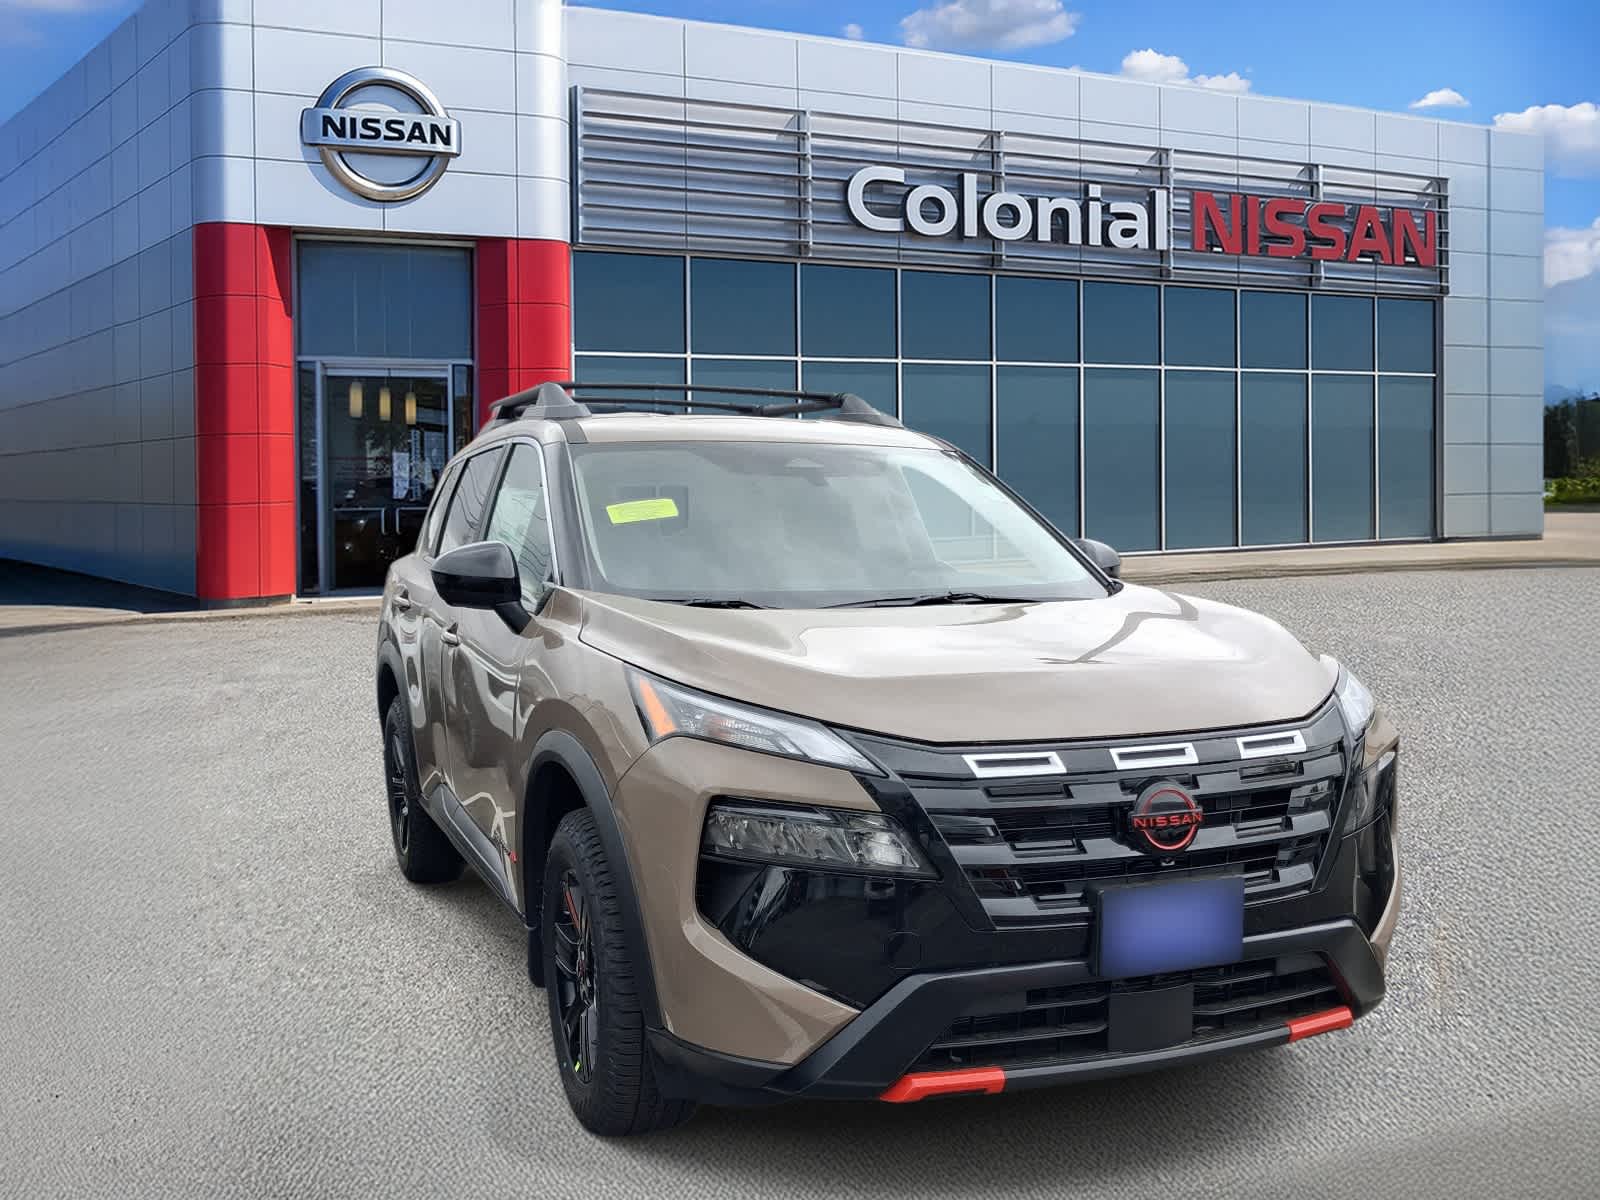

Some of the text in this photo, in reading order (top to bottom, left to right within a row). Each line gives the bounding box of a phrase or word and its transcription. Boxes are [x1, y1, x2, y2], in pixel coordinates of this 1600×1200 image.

[321, 115, 452, 146] NISSAN
[847, 165, 1436, 266] Colonial NISSAN
[1132, 811, 1202, 828] NISSAN
